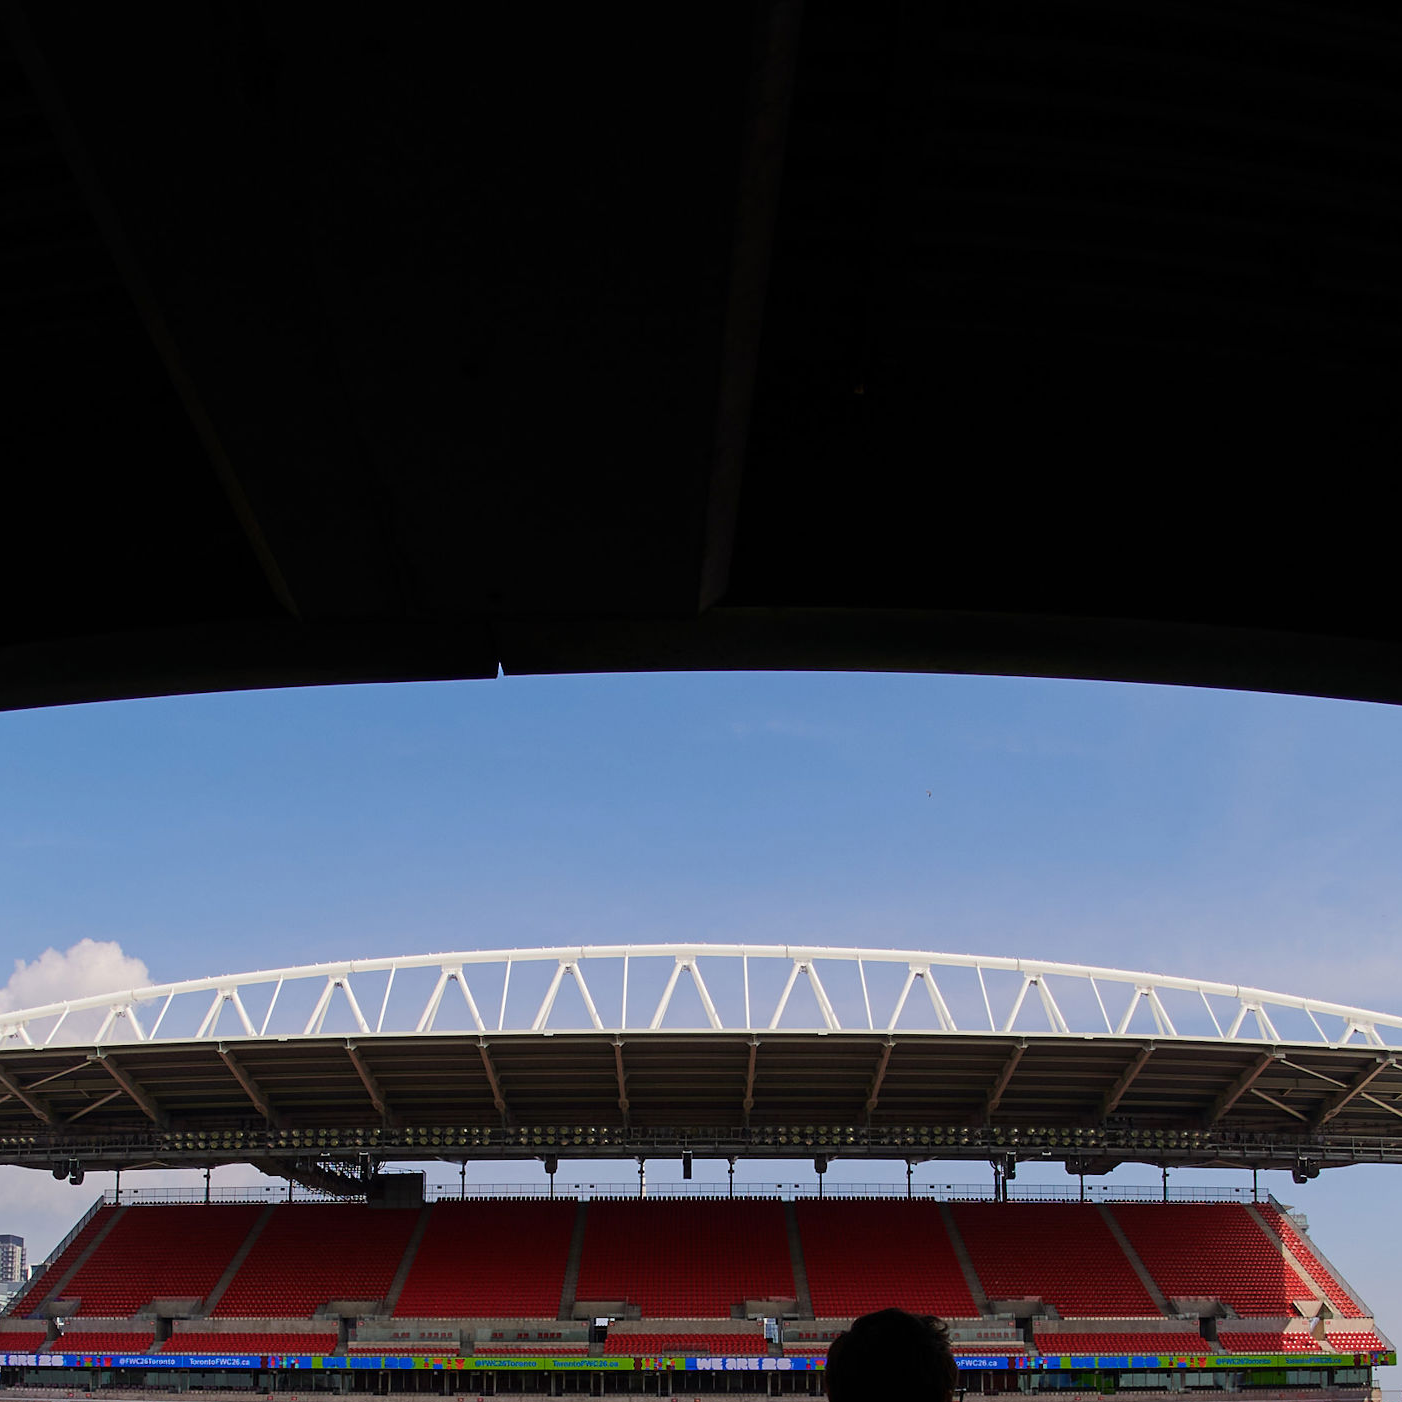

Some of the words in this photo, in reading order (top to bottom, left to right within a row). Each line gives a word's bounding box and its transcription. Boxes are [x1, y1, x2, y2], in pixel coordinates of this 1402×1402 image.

[9, 1354, 37, 1366] ARE
[119, 1357, 175, 1366] @FWC26Toronto
[189, 1358, 251, 1367] TorontoFWC26.ca
[696, 1358, 723, 1370] WE
[726, 1358, 760, 1370] ARE
[955, 1359, 998, 1367] oFWC26.ca
